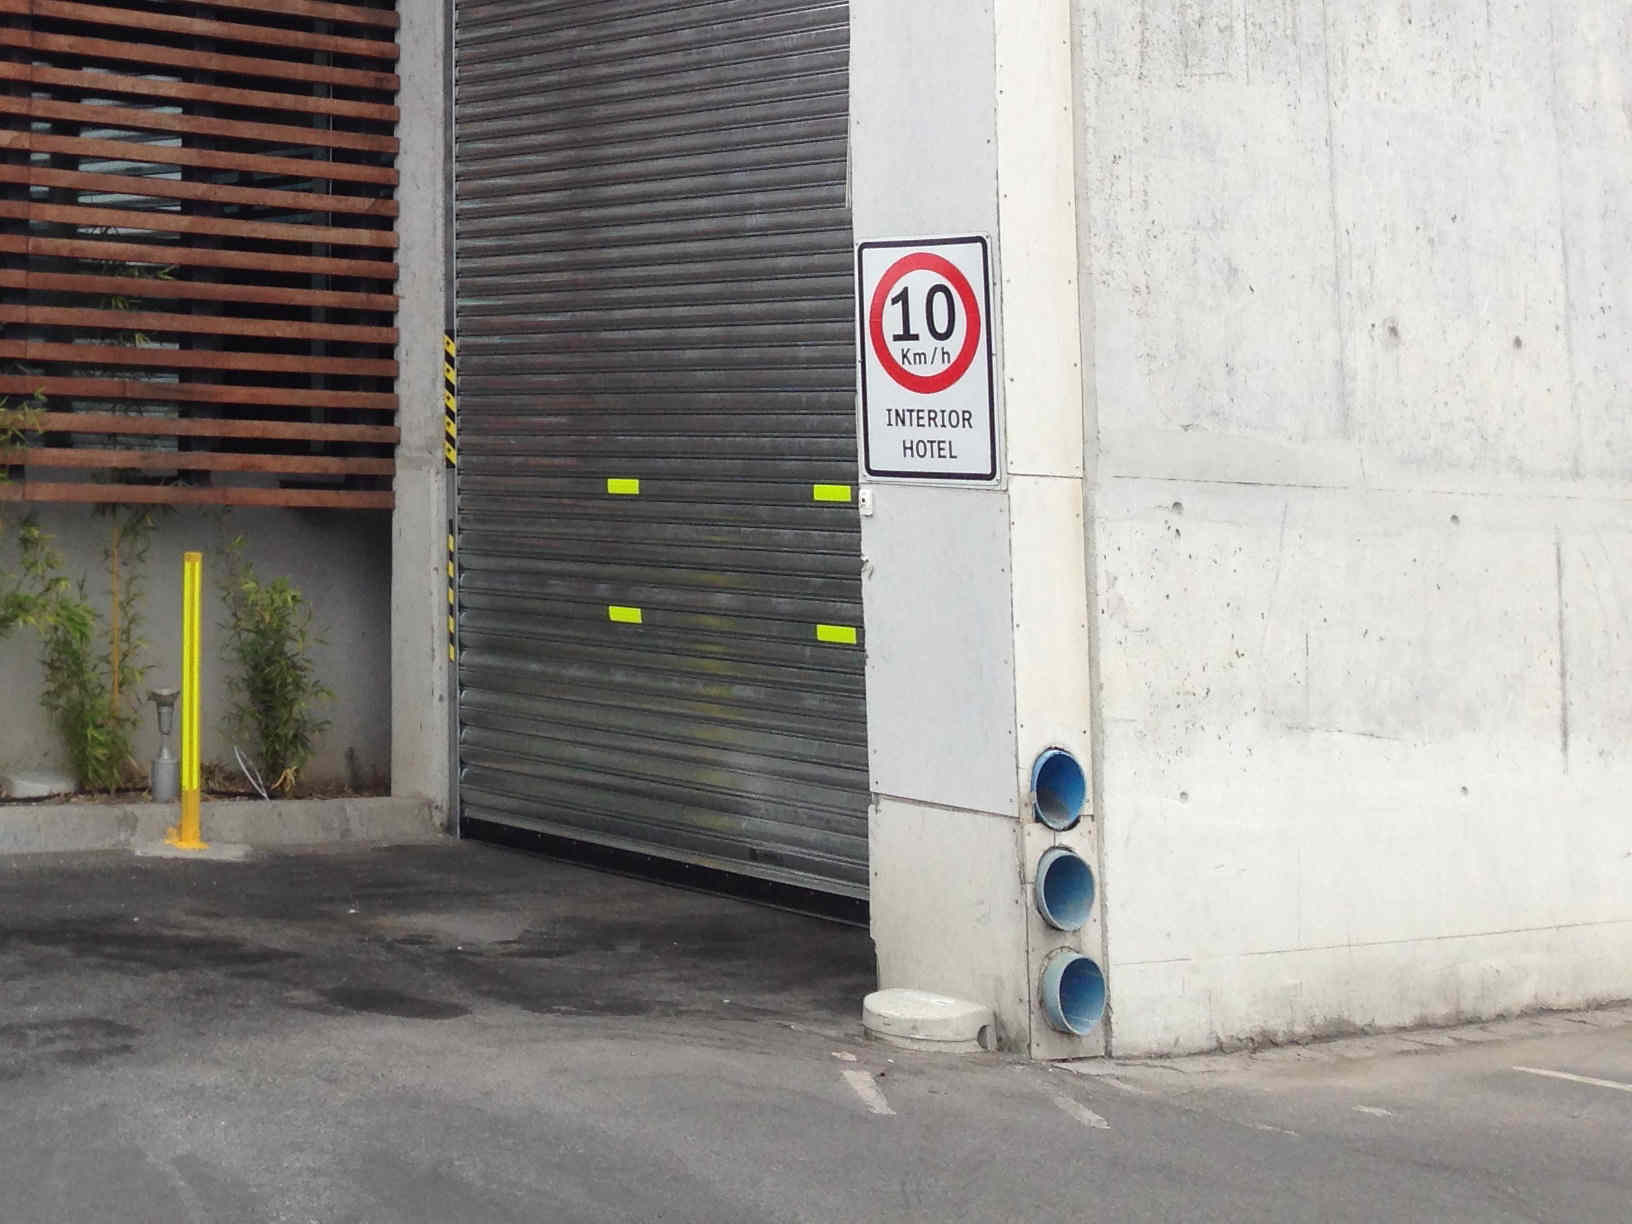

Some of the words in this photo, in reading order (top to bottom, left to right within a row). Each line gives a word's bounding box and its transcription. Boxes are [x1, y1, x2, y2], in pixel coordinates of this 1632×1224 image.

[891, 284, 955, 342] 10
[901, 347, 951, 366] Km/h
[886, 409, 973, 428] INTERIOR
[903, 440, 957, 459] HOTEL
